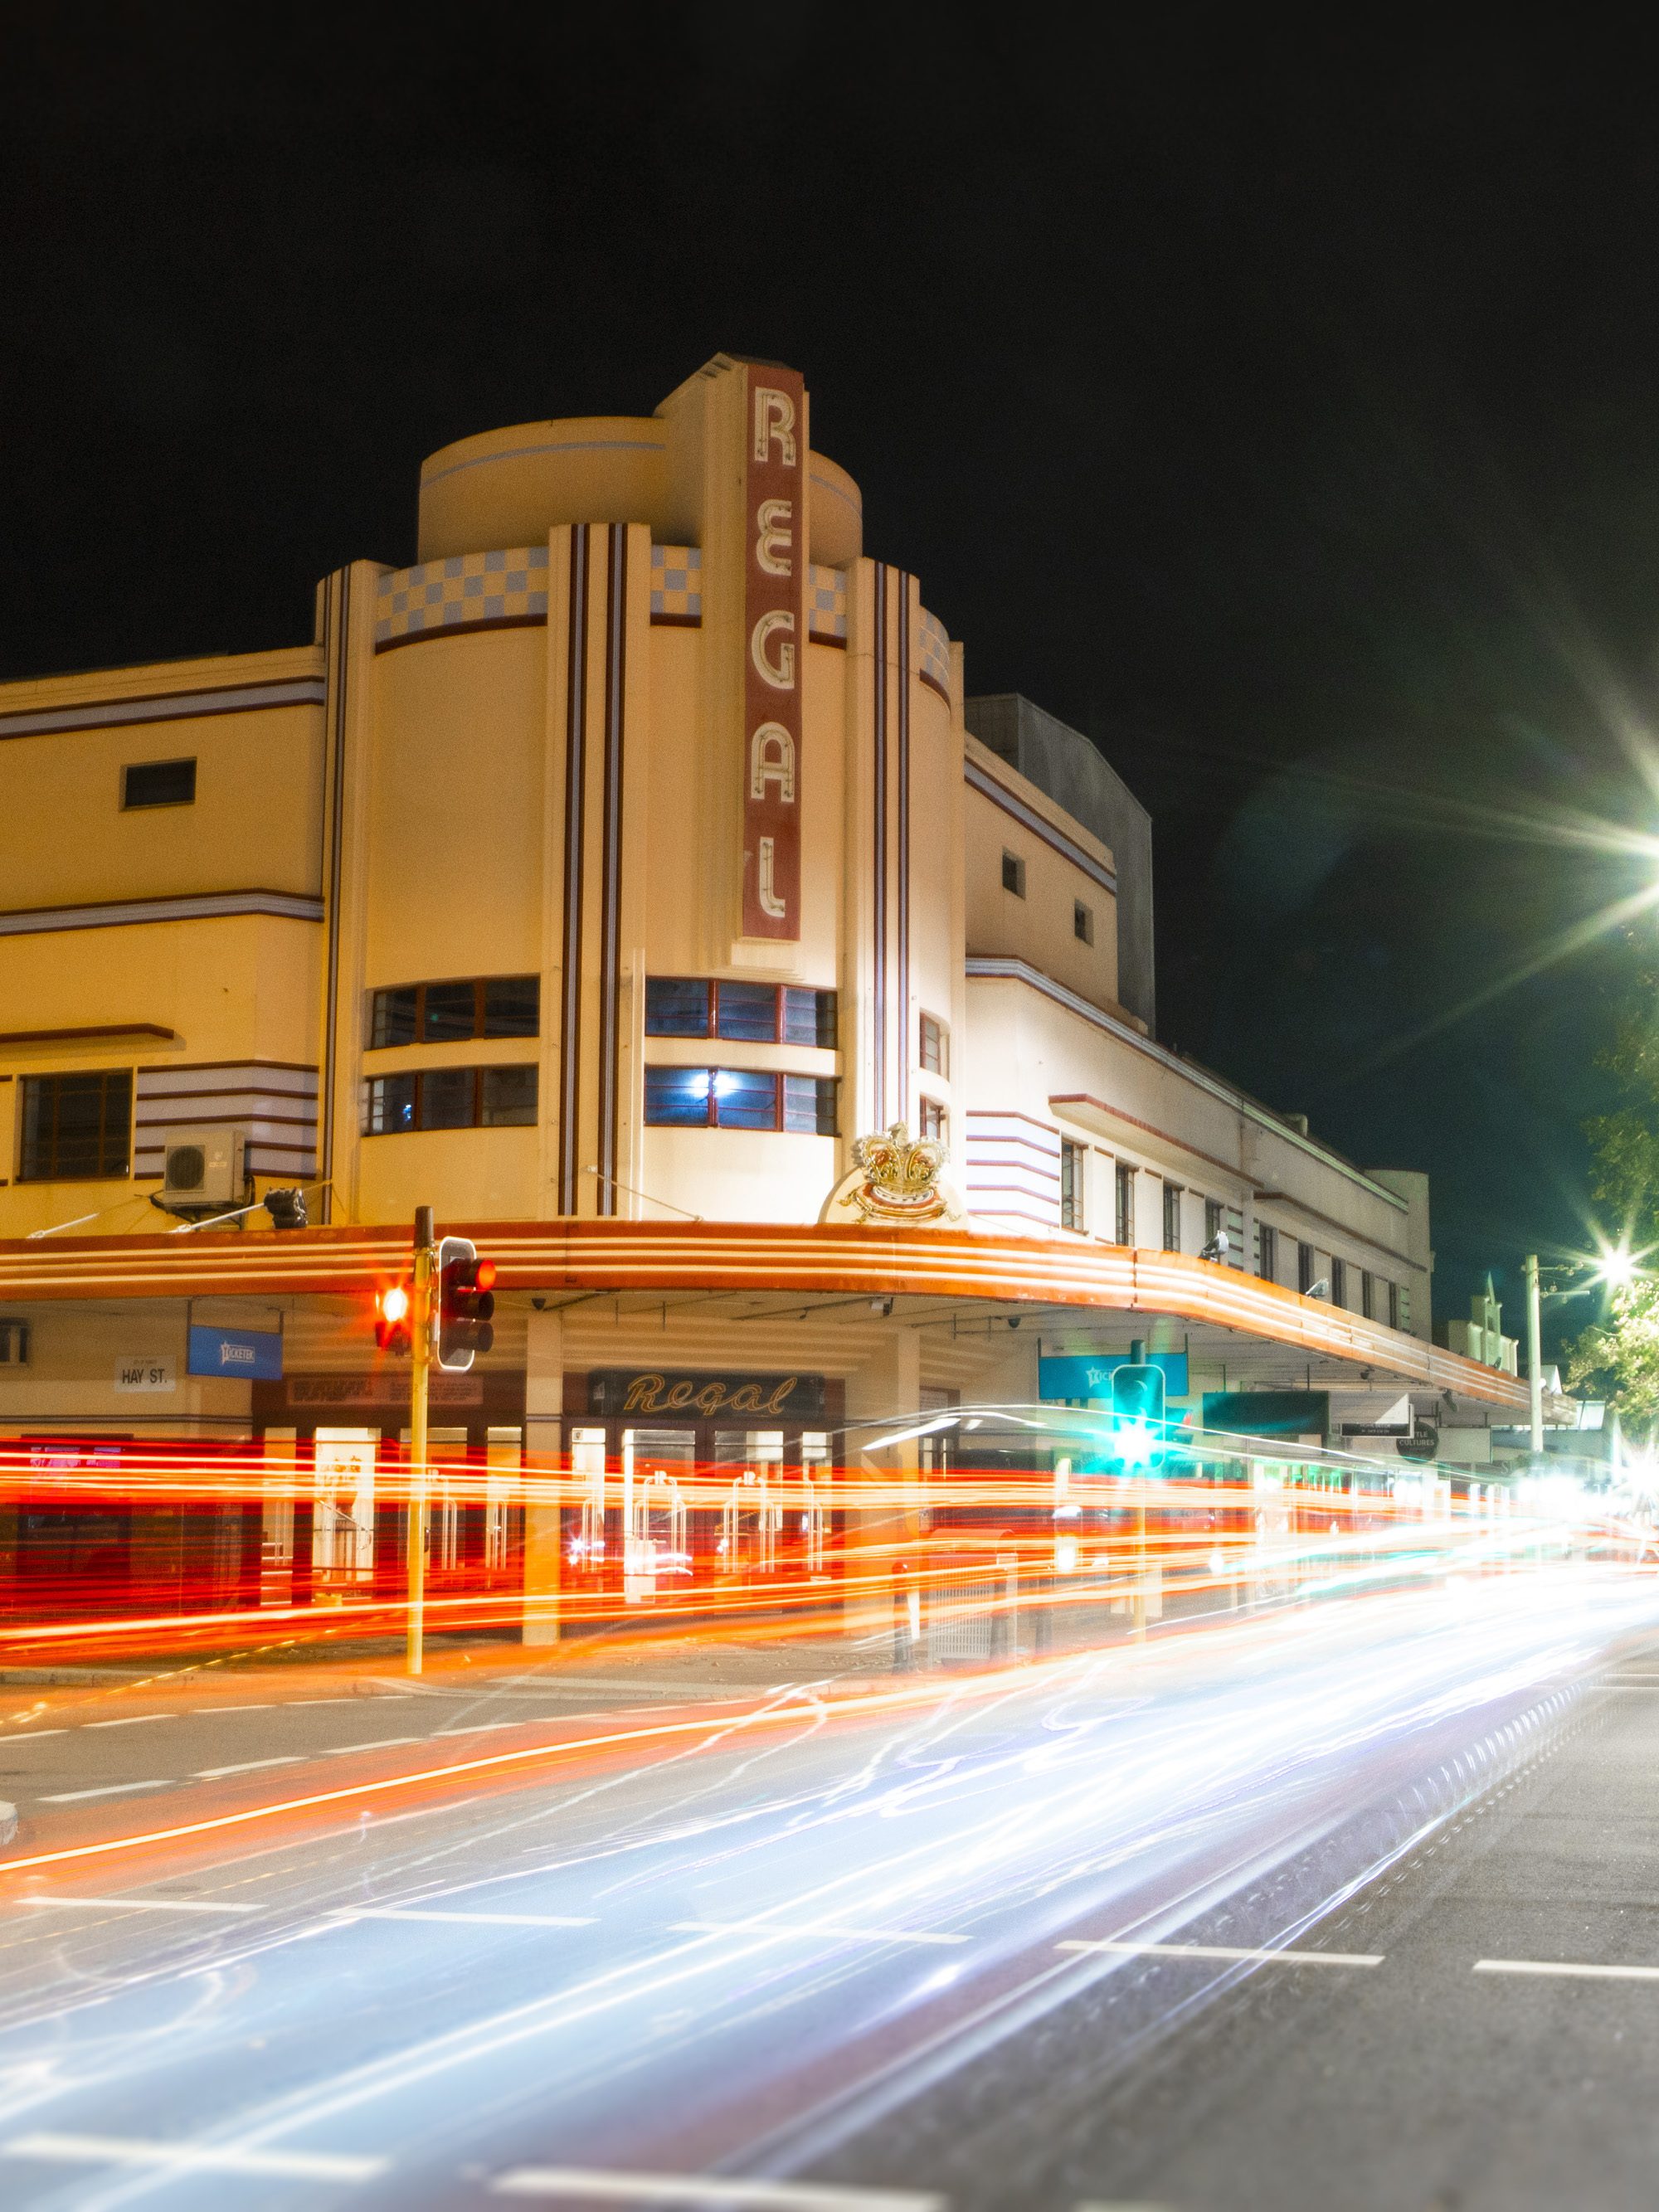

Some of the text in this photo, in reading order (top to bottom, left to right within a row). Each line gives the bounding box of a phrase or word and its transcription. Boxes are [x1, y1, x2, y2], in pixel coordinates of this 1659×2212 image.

[751, 386, 796, 918] REGAL
[122, 1369, 144, 1383] HAY
[624, 1373, 797, 1416] Regal
